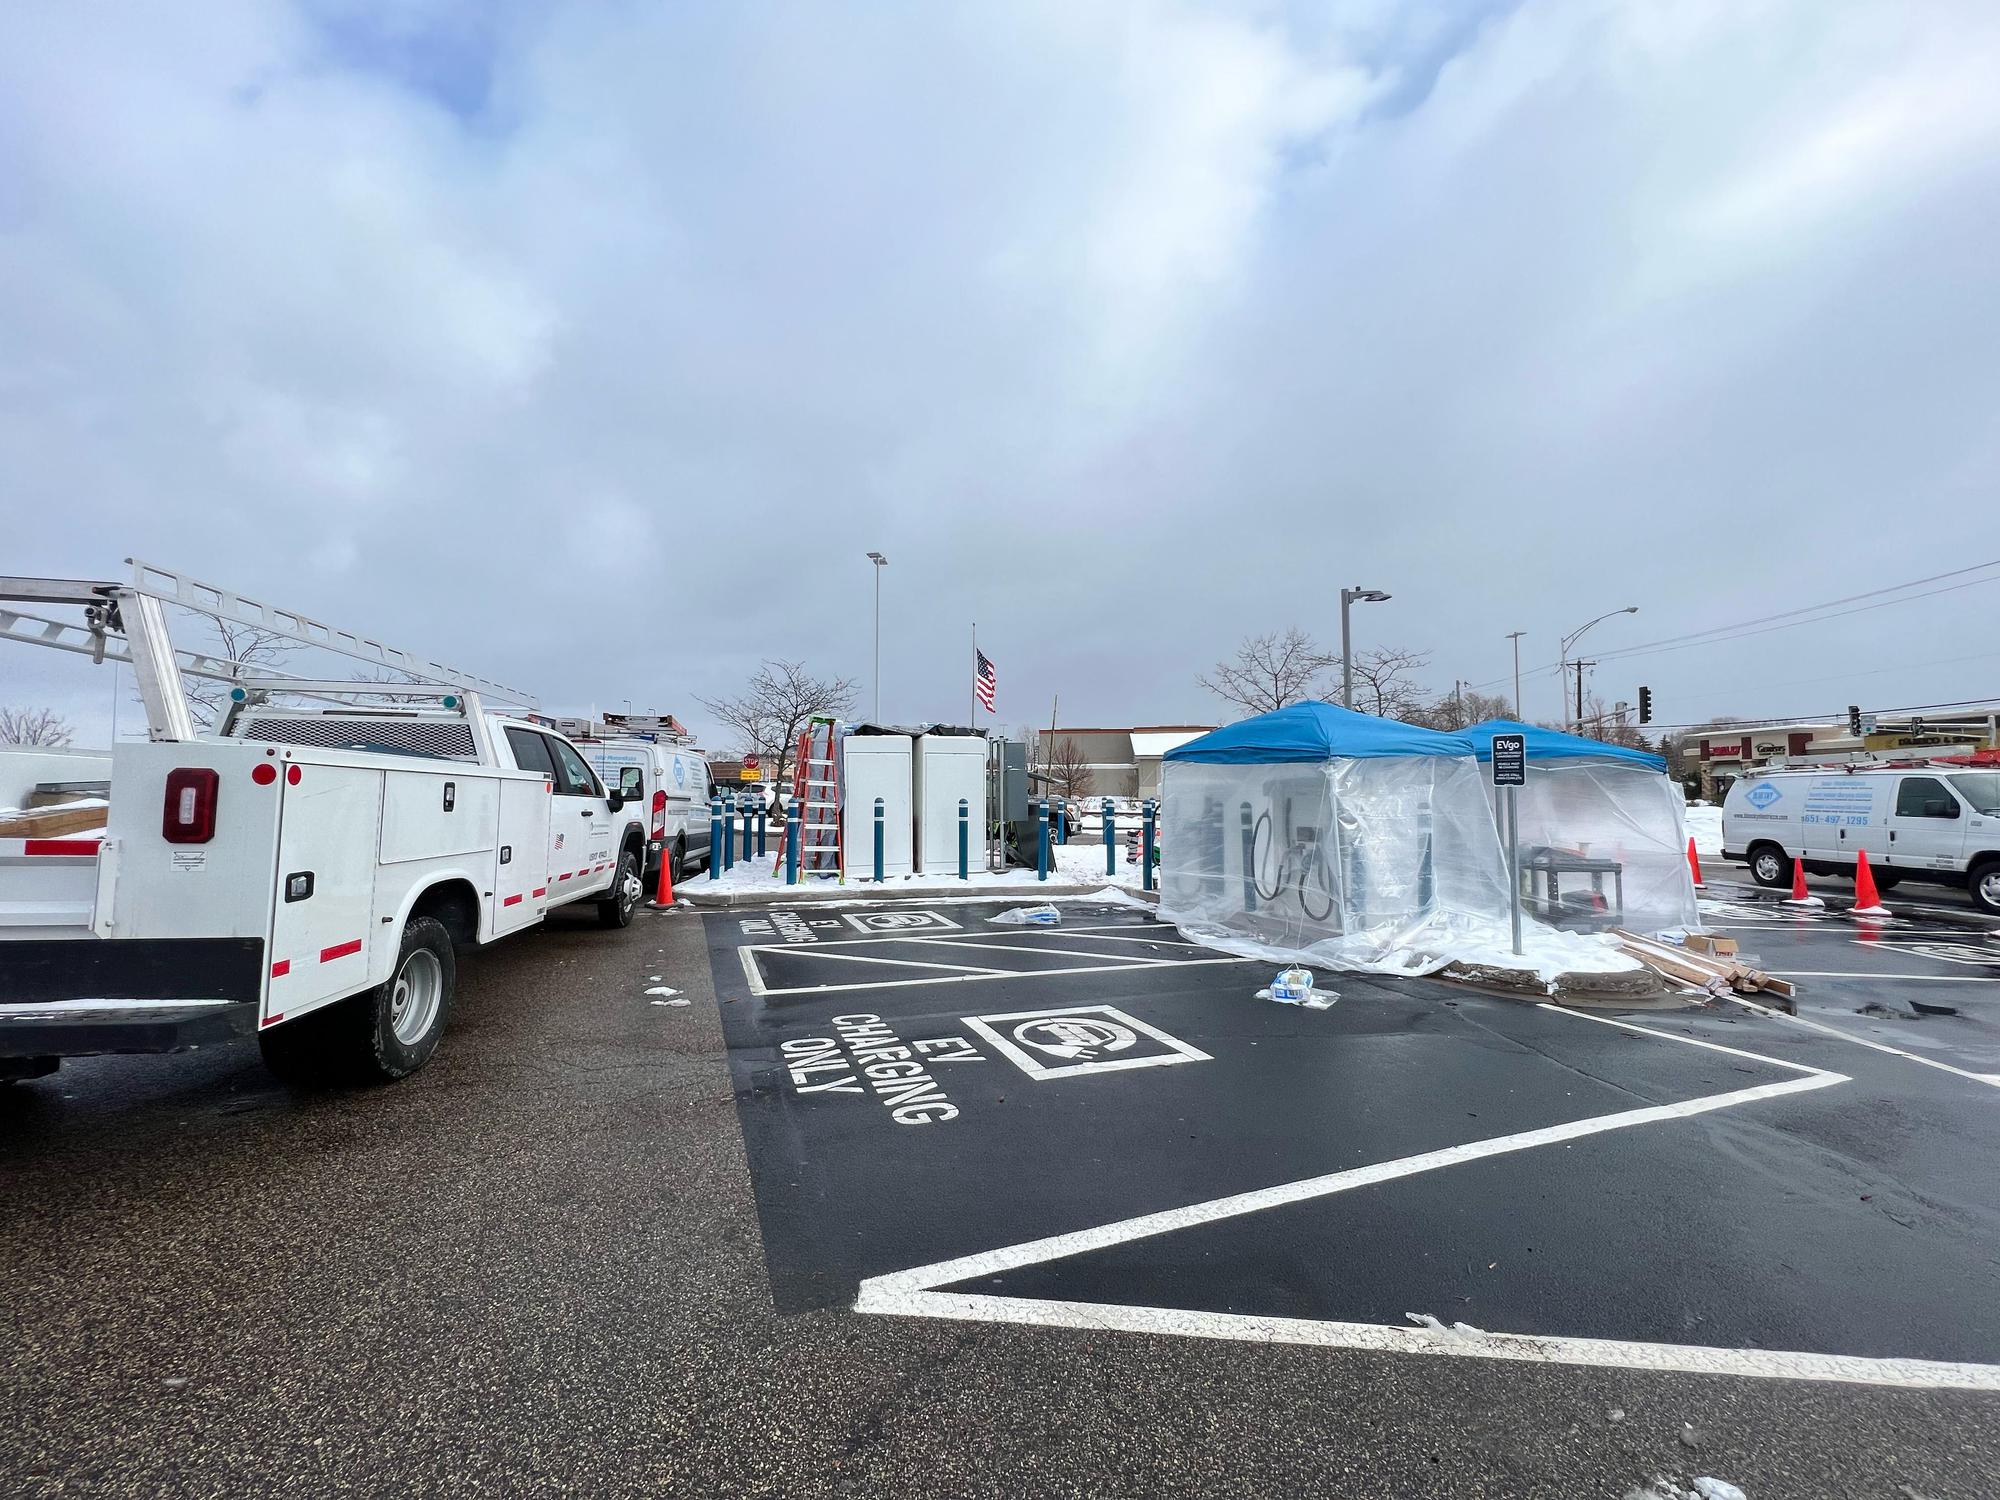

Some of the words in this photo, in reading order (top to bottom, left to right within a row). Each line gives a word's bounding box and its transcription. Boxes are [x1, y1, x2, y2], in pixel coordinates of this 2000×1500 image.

[1496, 740, 1520, 751] EVgo
[1805, 814, 1868, 825] 651-497-1295
[739, 919, 776, 935] ONLY
[769, 911, 818, 942] CHARGING
[809, 919, 843, 928] EV
[912, 1036, 987, 1062] EV
[780, 1037, 864, 1093] ONLY
[831, 1013, 960, 1125] CHARGING
